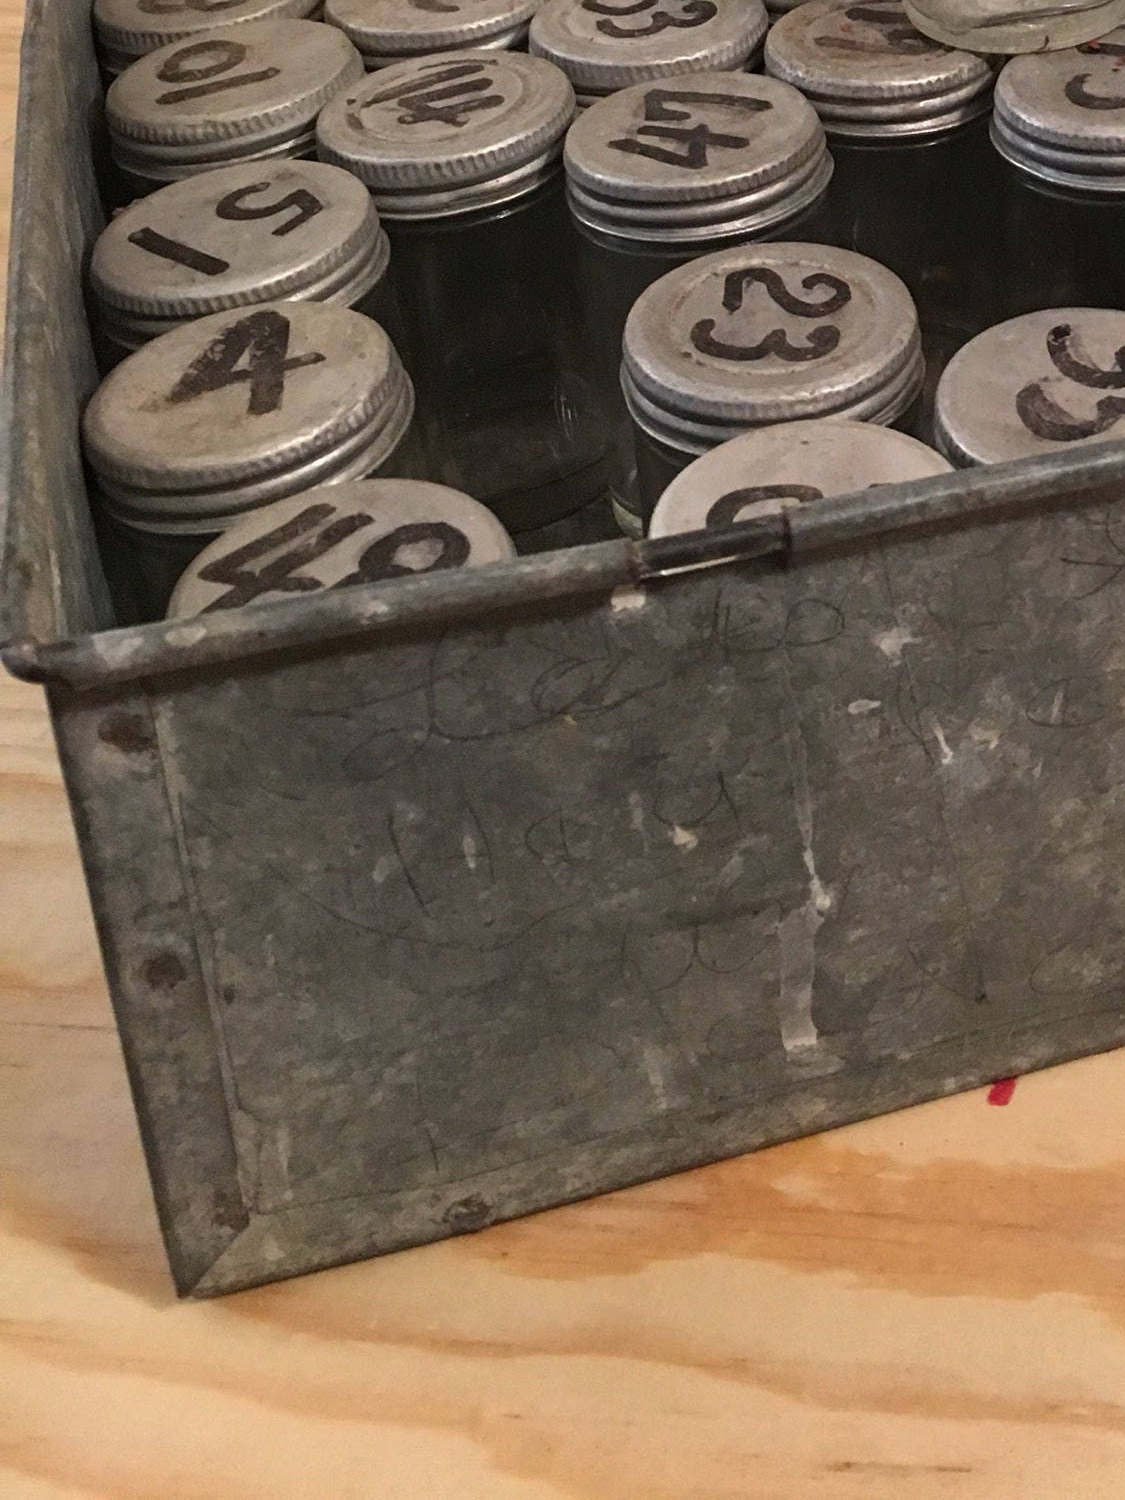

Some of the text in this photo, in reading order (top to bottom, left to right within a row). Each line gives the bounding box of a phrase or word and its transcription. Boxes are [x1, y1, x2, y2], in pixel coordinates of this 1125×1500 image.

[607, 89, 772, 169] 47
[145, 309, 326, 415] 4
[690, 268, 851, 362] 23
